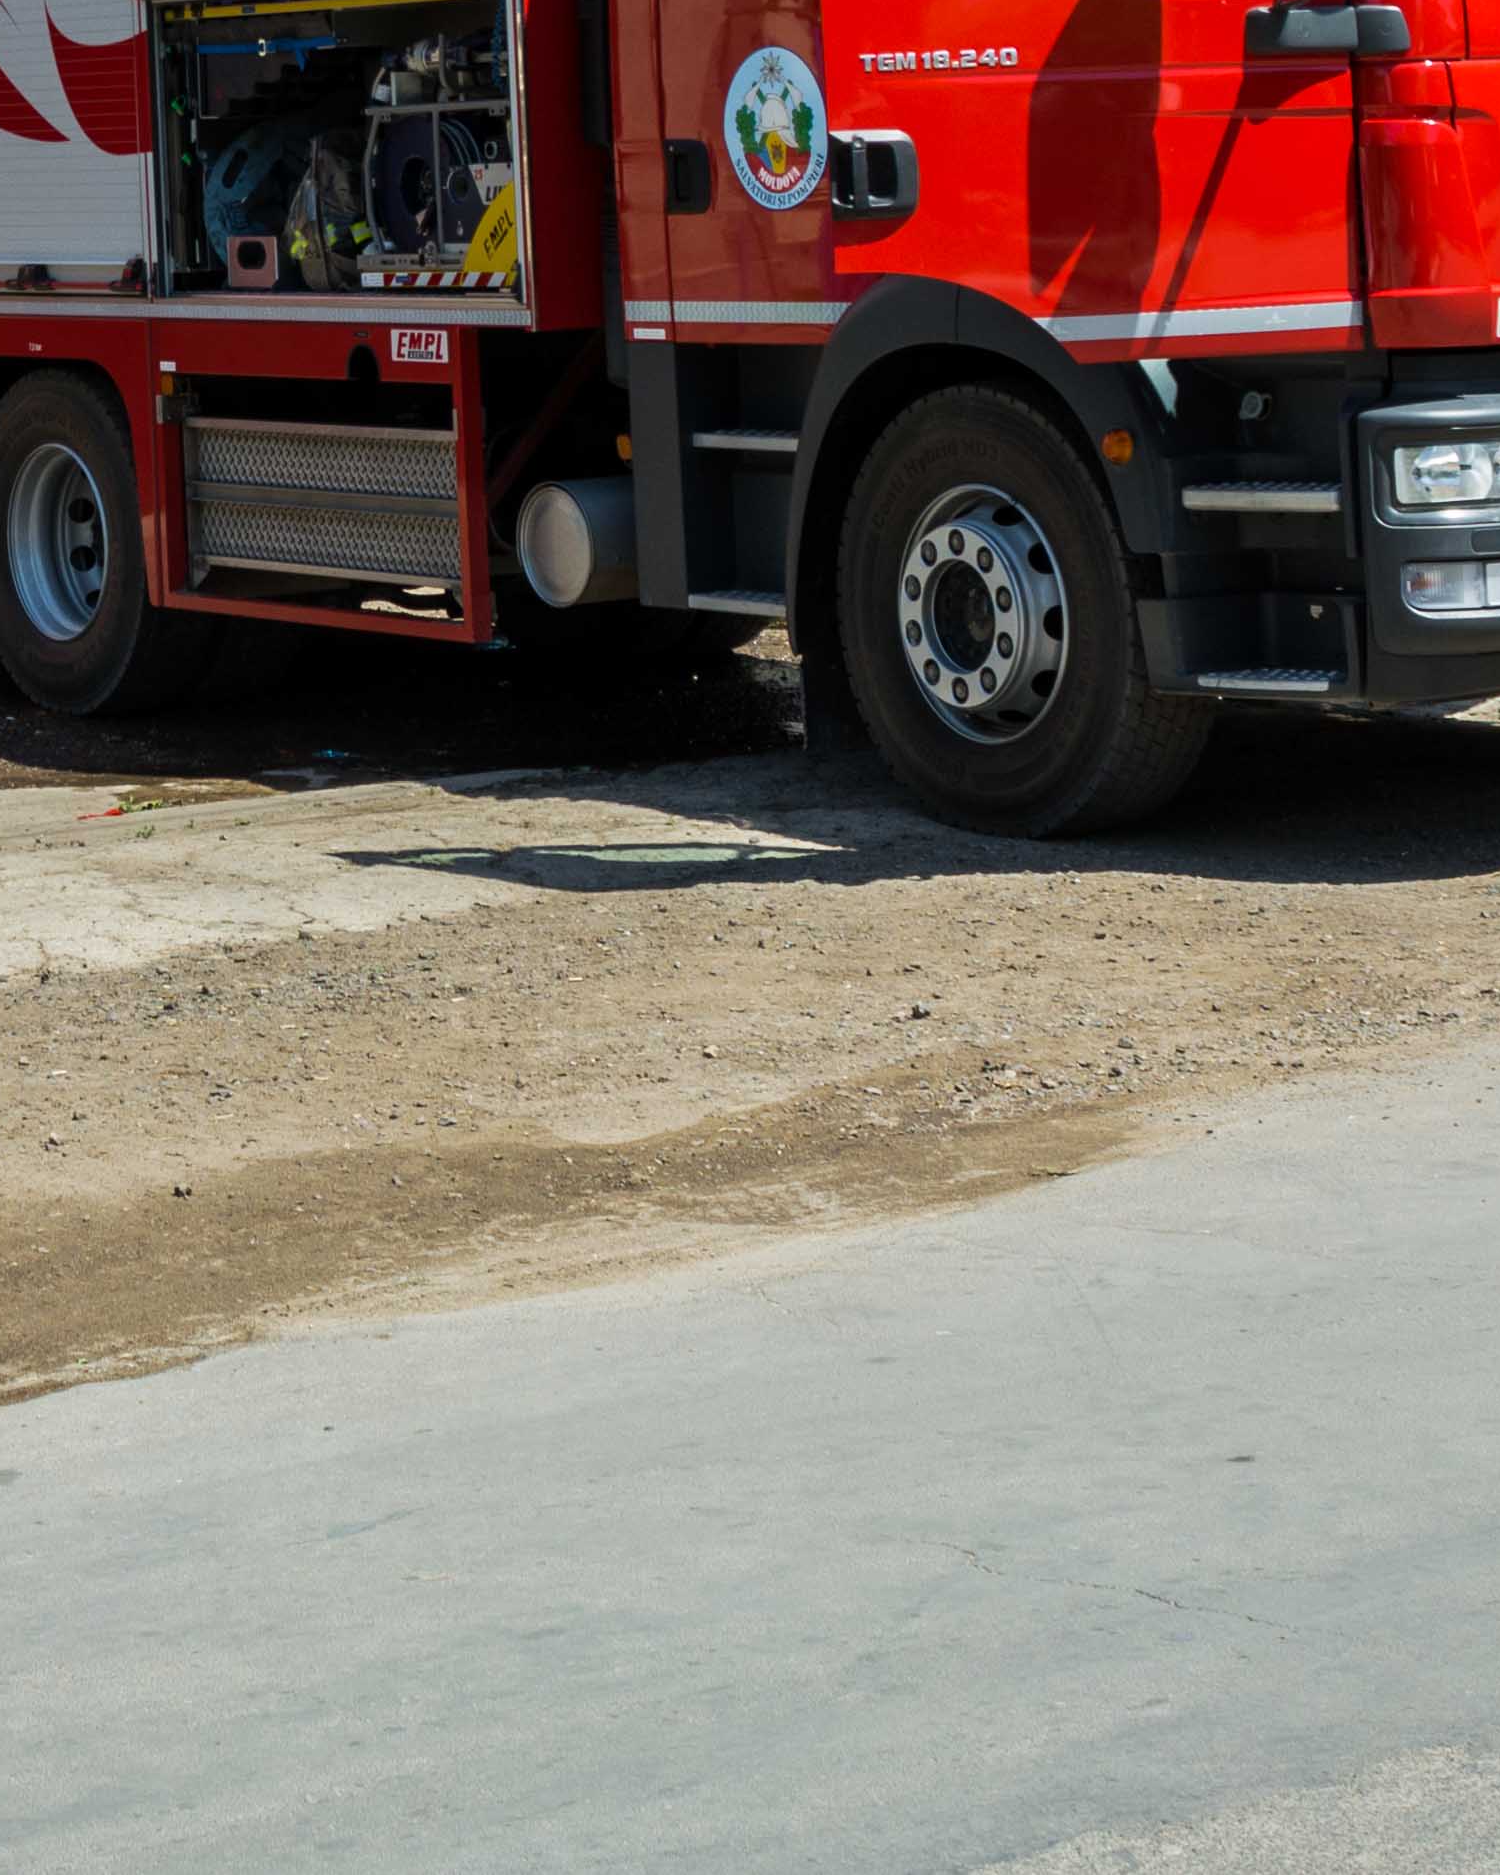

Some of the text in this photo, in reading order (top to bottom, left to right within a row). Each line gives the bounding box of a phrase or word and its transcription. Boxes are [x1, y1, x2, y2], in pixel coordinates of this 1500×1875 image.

[859, 46, 1018, 73] TGM 18.240
[757, 166, 801, 190] MOLDOVA
[787, 153, 825, 205] POMPIERI
[396, 332, 443, 359] EMPL
